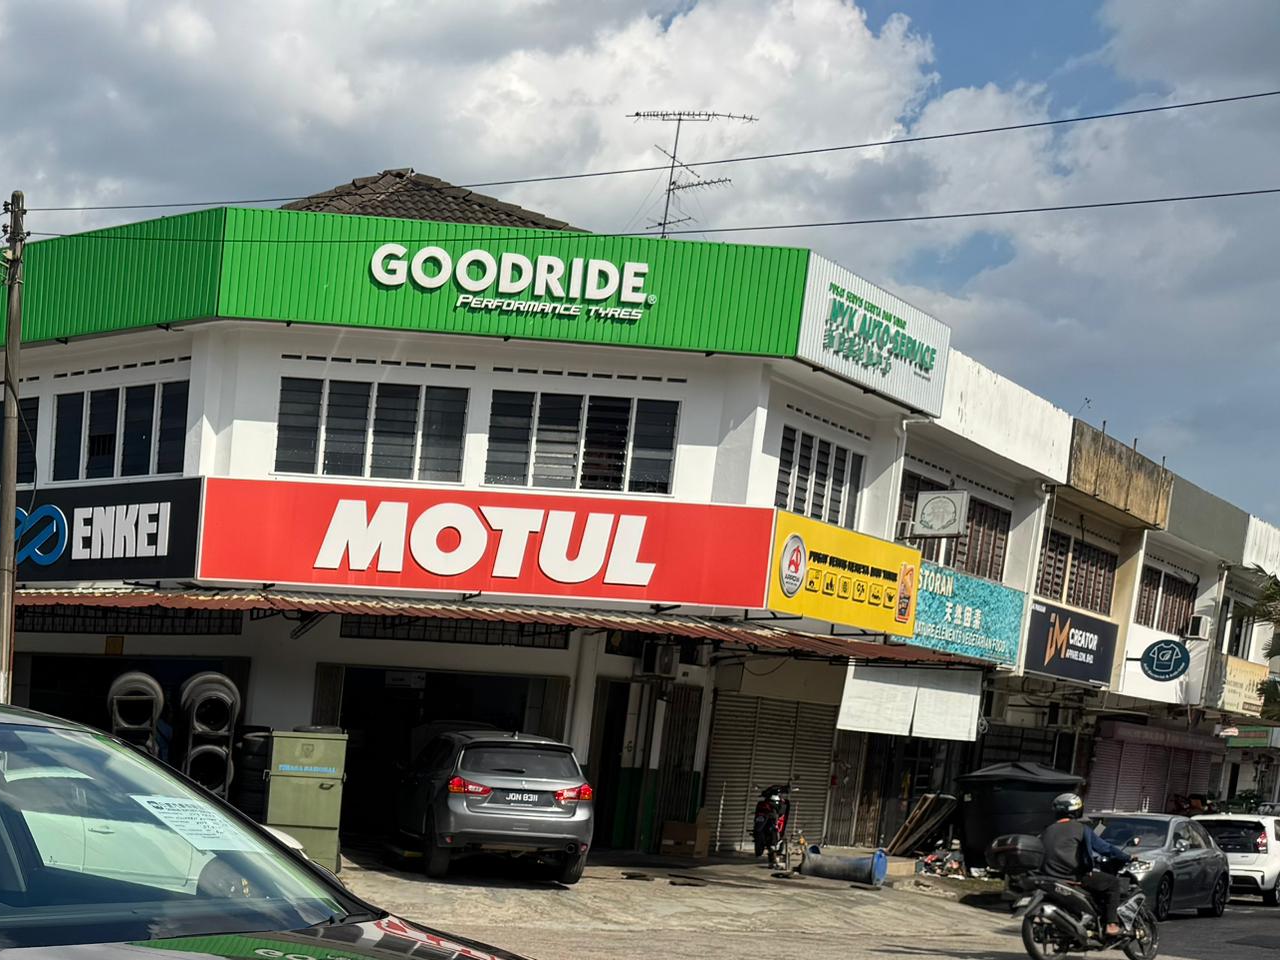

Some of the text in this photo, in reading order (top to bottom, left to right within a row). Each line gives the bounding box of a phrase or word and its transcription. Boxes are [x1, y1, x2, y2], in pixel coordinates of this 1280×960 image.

[371, 243, 650, 305] GOODRIDE
[456, 294, 644, 320] PERFORMANCE TYRES
[860, 313, 891, 351] AUTO
[891, 329, 937, 371] SERVICE
[71, 502, 171, 560] ENKEI
[313, 499, 656, 586] MOTUL
[1069, 628, 1099, 651] CREATOR
